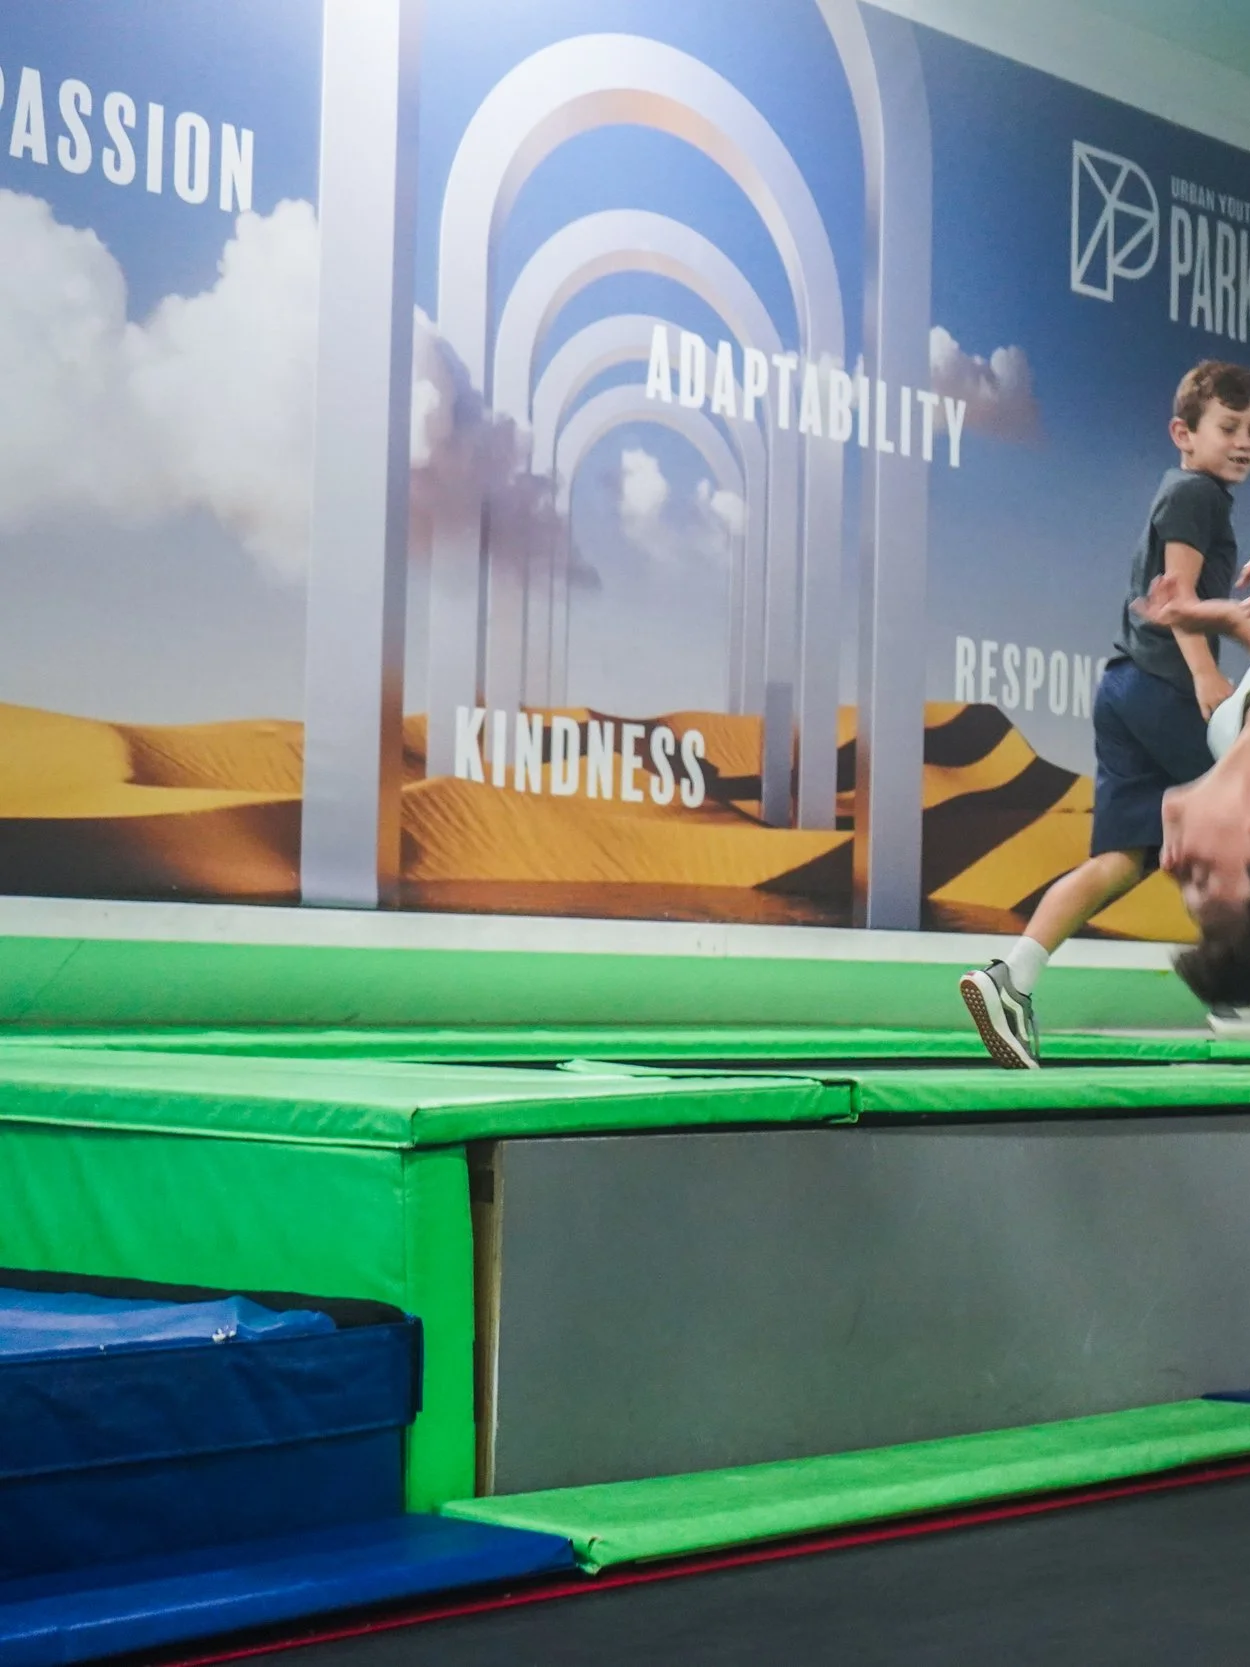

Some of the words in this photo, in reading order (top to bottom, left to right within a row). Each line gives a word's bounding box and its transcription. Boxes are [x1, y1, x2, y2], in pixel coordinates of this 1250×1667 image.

[0, 66, 254, 213] ASSION
[1171, 175, 1215, 212] URBAN
[646, 324, 966, 468] ADAPTABILITY
[454, 706, 706, 808] KINDNESS
